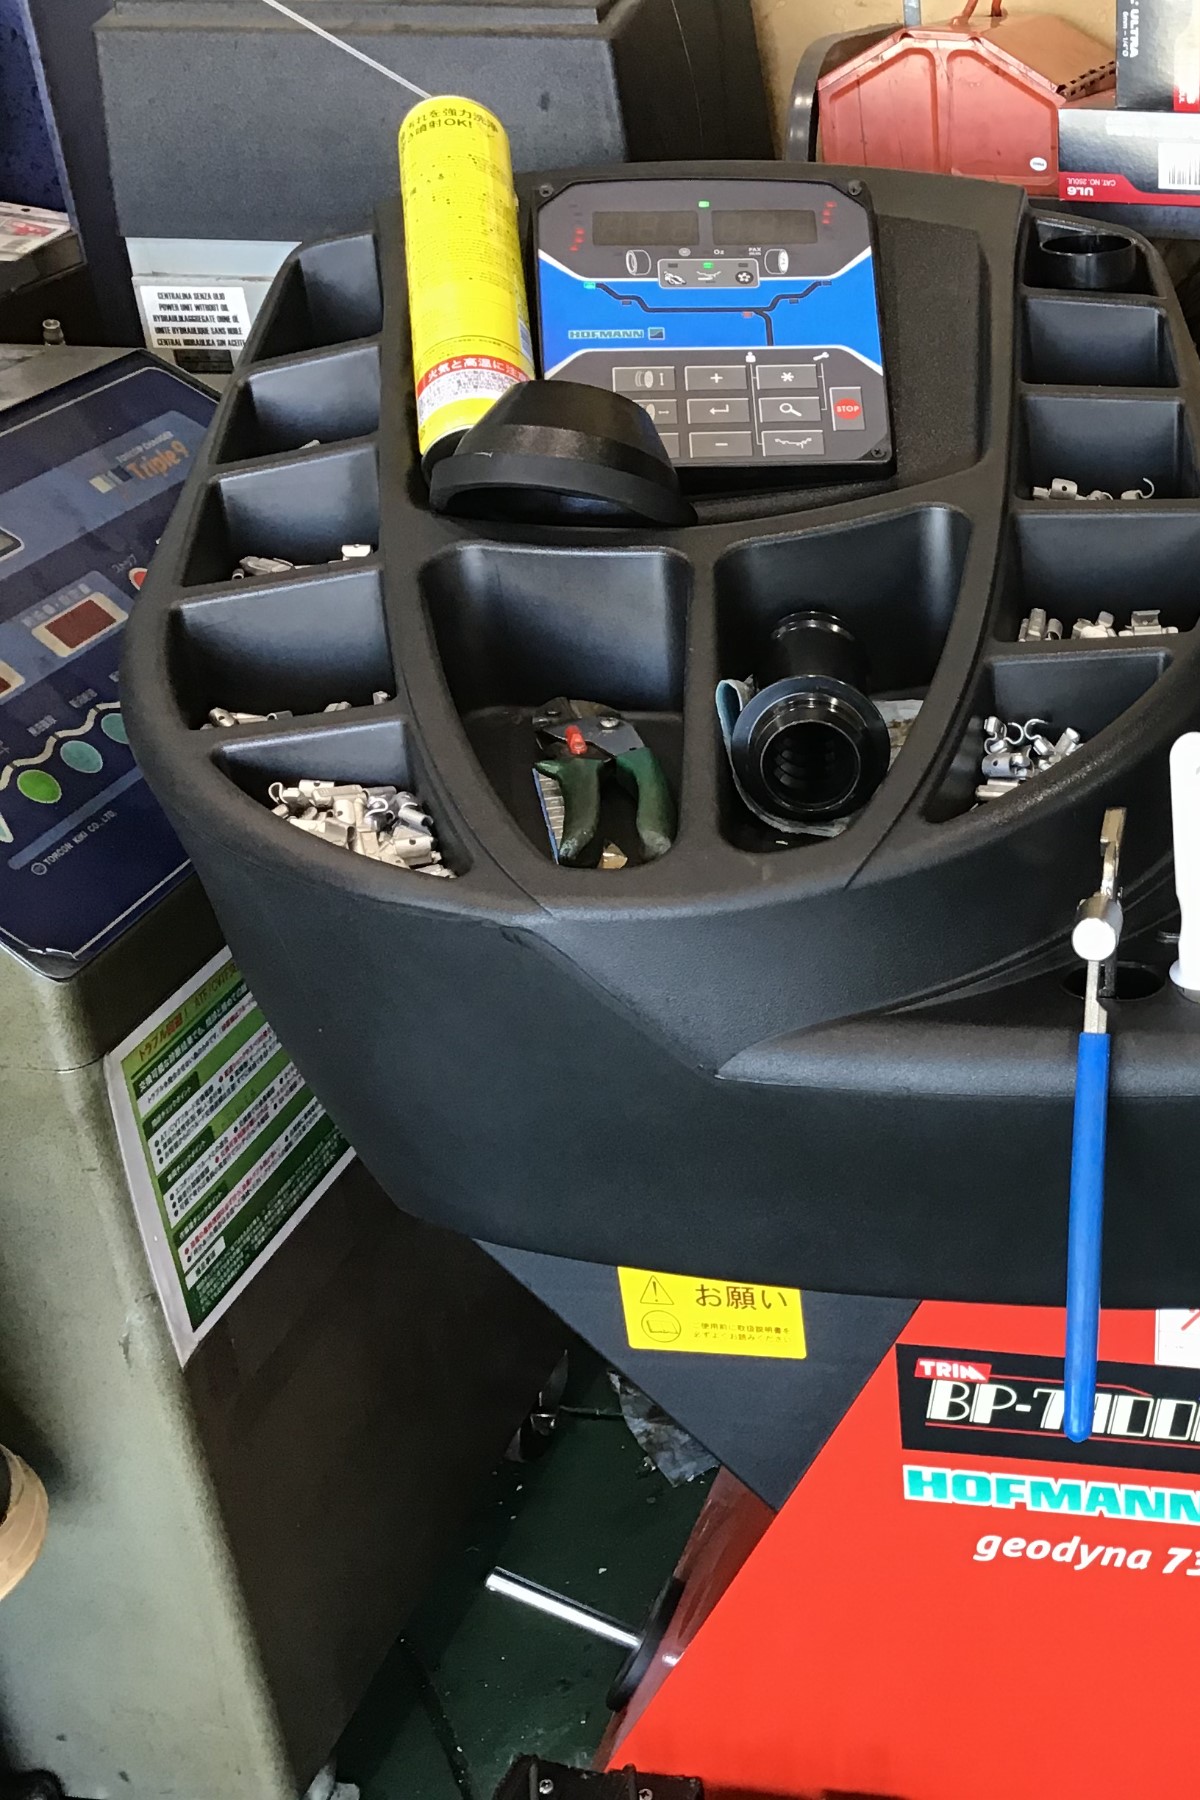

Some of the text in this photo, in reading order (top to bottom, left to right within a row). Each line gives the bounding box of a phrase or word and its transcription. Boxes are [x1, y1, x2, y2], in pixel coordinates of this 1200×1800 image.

[1130, 9, 1139, 58] ULTRA
[1067, 187, 1094, 196] UL6
[157, 292, 192, 301] CENTRALINA
[193, 292, 212, 301] SENZA
[159, 303, 180, 312] POWER
[180, 303, 193, 312] UNIT
[194, 303, 219, 312] WITHOUT
[211, 327, 227, 335] SANS
[568, 329, 644, 340] HOFMANN
[157, 338, 182, 347] CENTRAL
[836, 405, 860, 413] STOP
[43, 842, 74, 866] TORCON
[695, 1284, 788, 1310] お願い
[919, 1360, 986, 1380] TRIM
[972, 1534, 1152, 1570] geodyna
